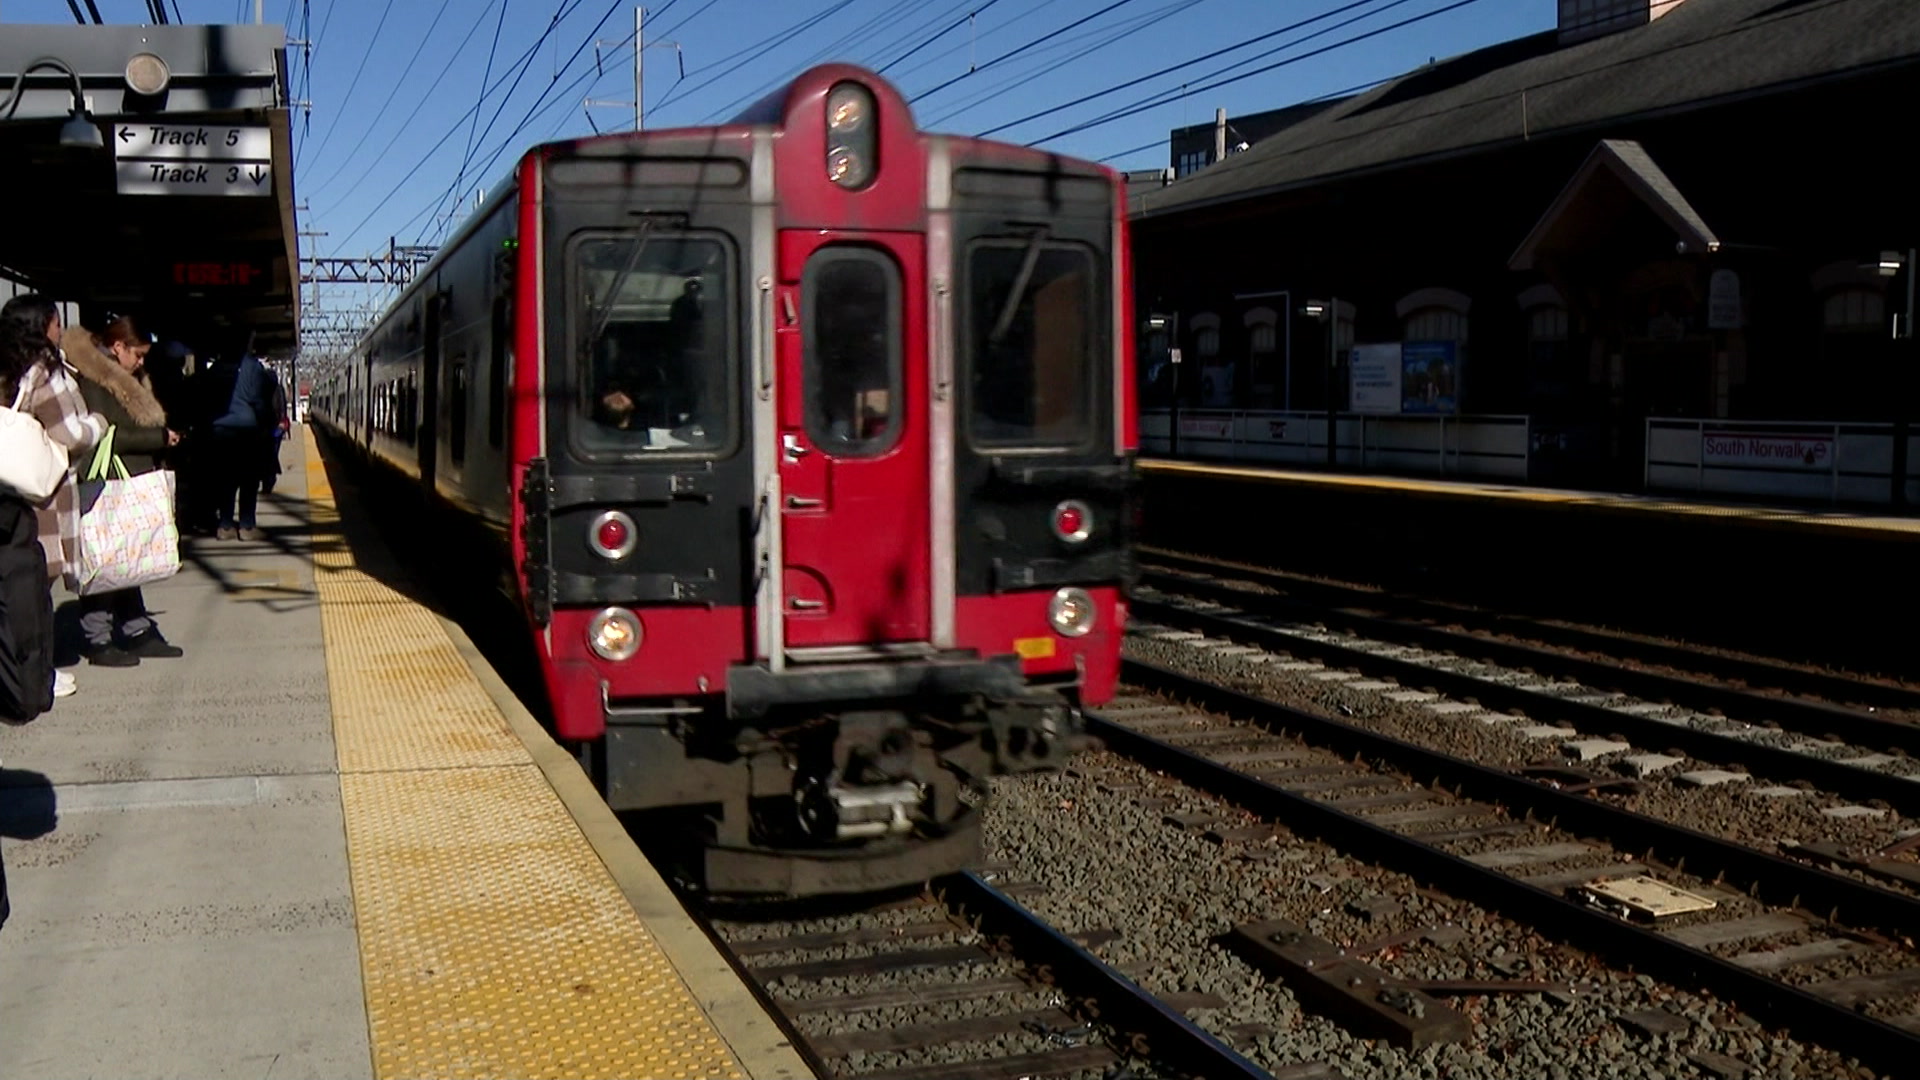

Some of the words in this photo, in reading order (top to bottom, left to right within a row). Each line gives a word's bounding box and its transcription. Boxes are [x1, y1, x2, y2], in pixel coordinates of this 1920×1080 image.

[150, 126, 208, 145] Track
[225, 129, 239, 147] 5
[150, 164, 208, 183] Track
[226, 166, 239, 184] 3
[1706, 437, 1745, 456] South
[1748, 439, 1804, 459] Norwalk
